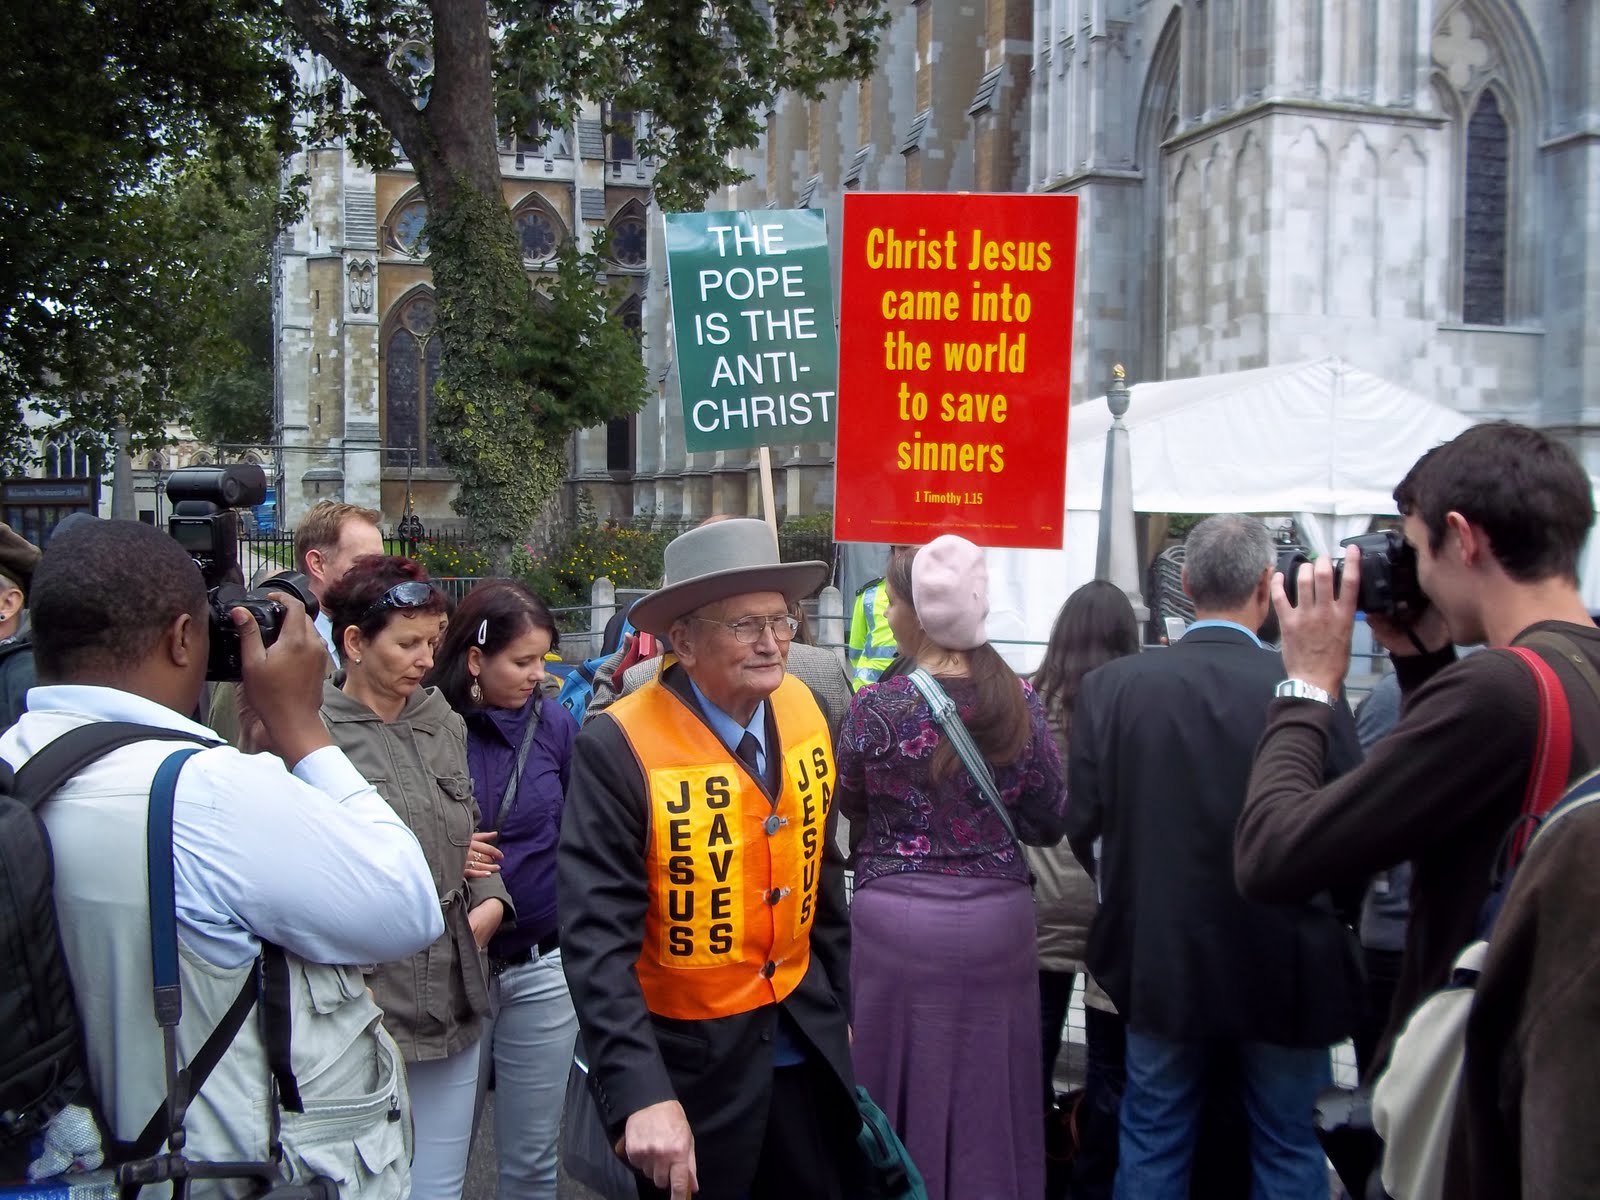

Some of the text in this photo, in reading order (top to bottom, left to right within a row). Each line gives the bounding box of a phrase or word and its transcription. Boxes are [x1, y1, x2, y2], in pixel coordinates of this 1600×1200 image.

[707, 224, 787, 257] THE
[866, 228, 1052, 271] Christ Jesus
[700, 266, 806, 302] POPE
[882, 281, 1031, 322] came into
[695, 308, 817, 345] IS THE
[711, 351, 810, 388] ANTI-
[884, 331, 1026, 373] the world
[692, 392, 835, 432] CHRIST
[898, 382, 1007, 423] to save
[897, 431, 1005, 473] sinners
[915, 491, 983, 506] 1 Timothy 1.15
[797, 759, 818, 925] JESUS
[667, 781, 694, 957] JESUS
[705, 776, 733, 955] SAVES
